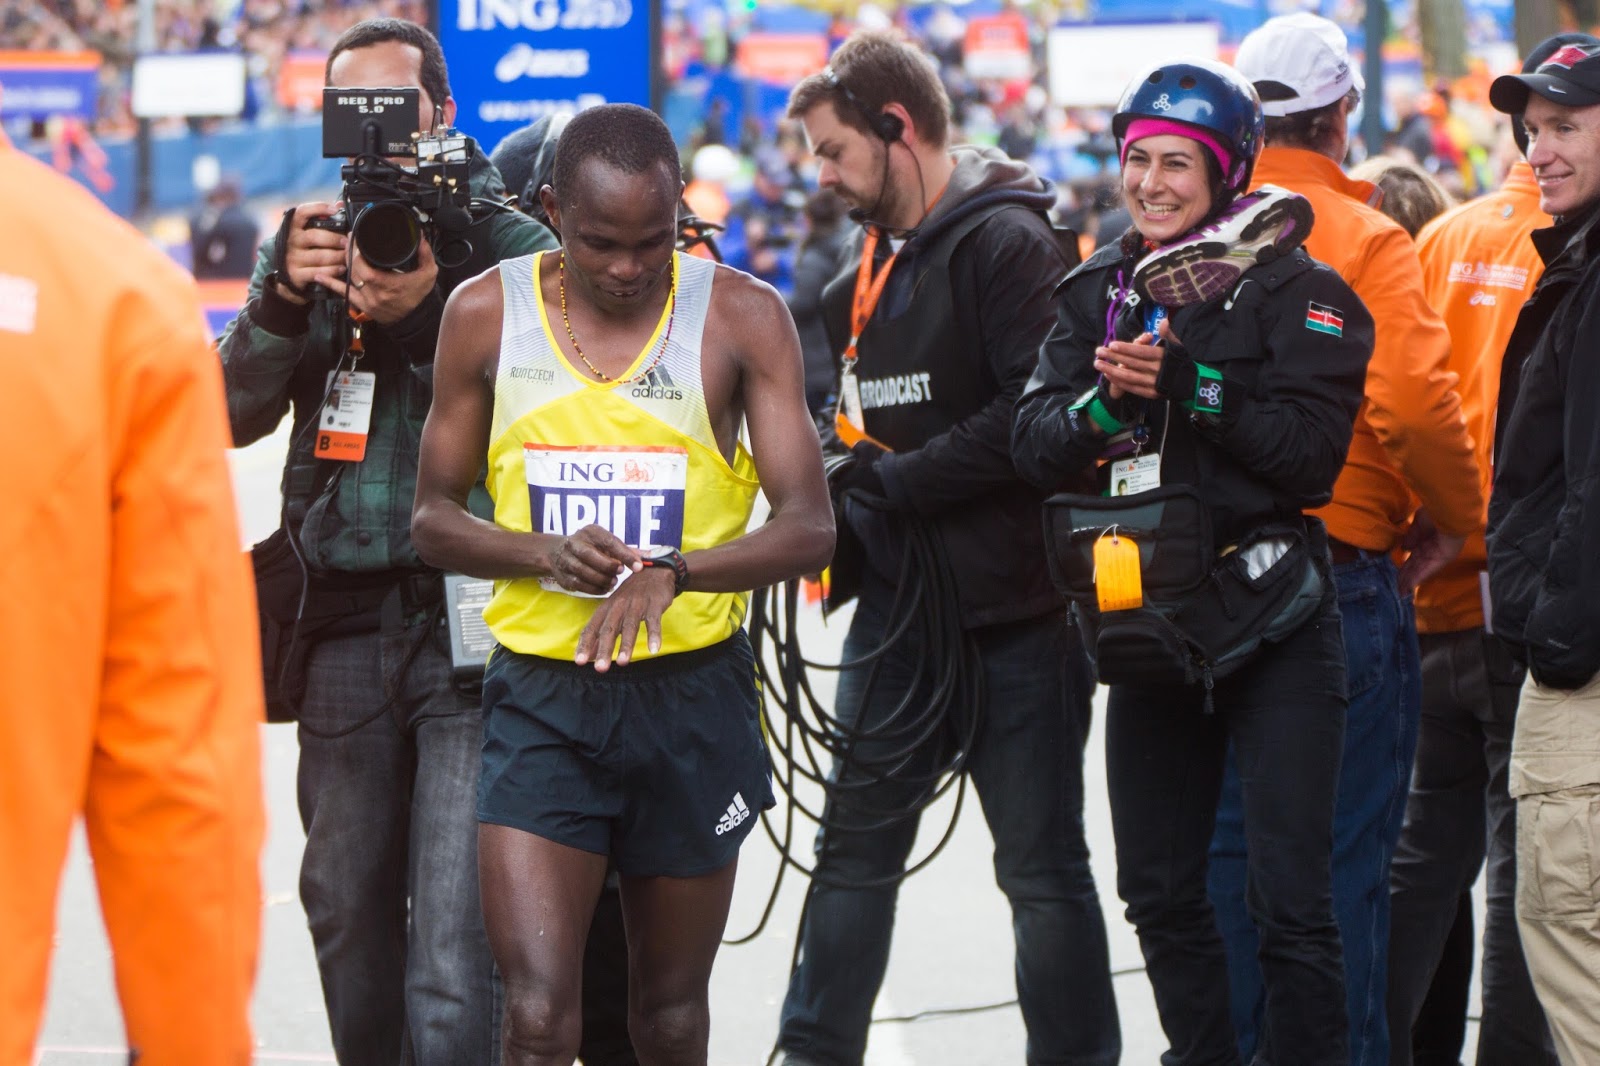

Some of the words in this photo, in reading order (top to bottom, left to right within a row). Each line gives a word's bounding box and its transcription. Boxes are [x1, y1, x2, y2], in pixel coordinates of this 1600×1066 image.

[457, 0, 560, 31] ING
[338, 97, 367, 105] RED
[374, 97, 404, 105] PRO
[359, 105, 385, 114] 5.0
[631, 387, 683, 400] adidas
[860, 372, 932, 410] BROADCAST
[319, 435, 331, 451] B
[558, 462, 615, 483] ING
[715, 807, 750, 836] adidas
